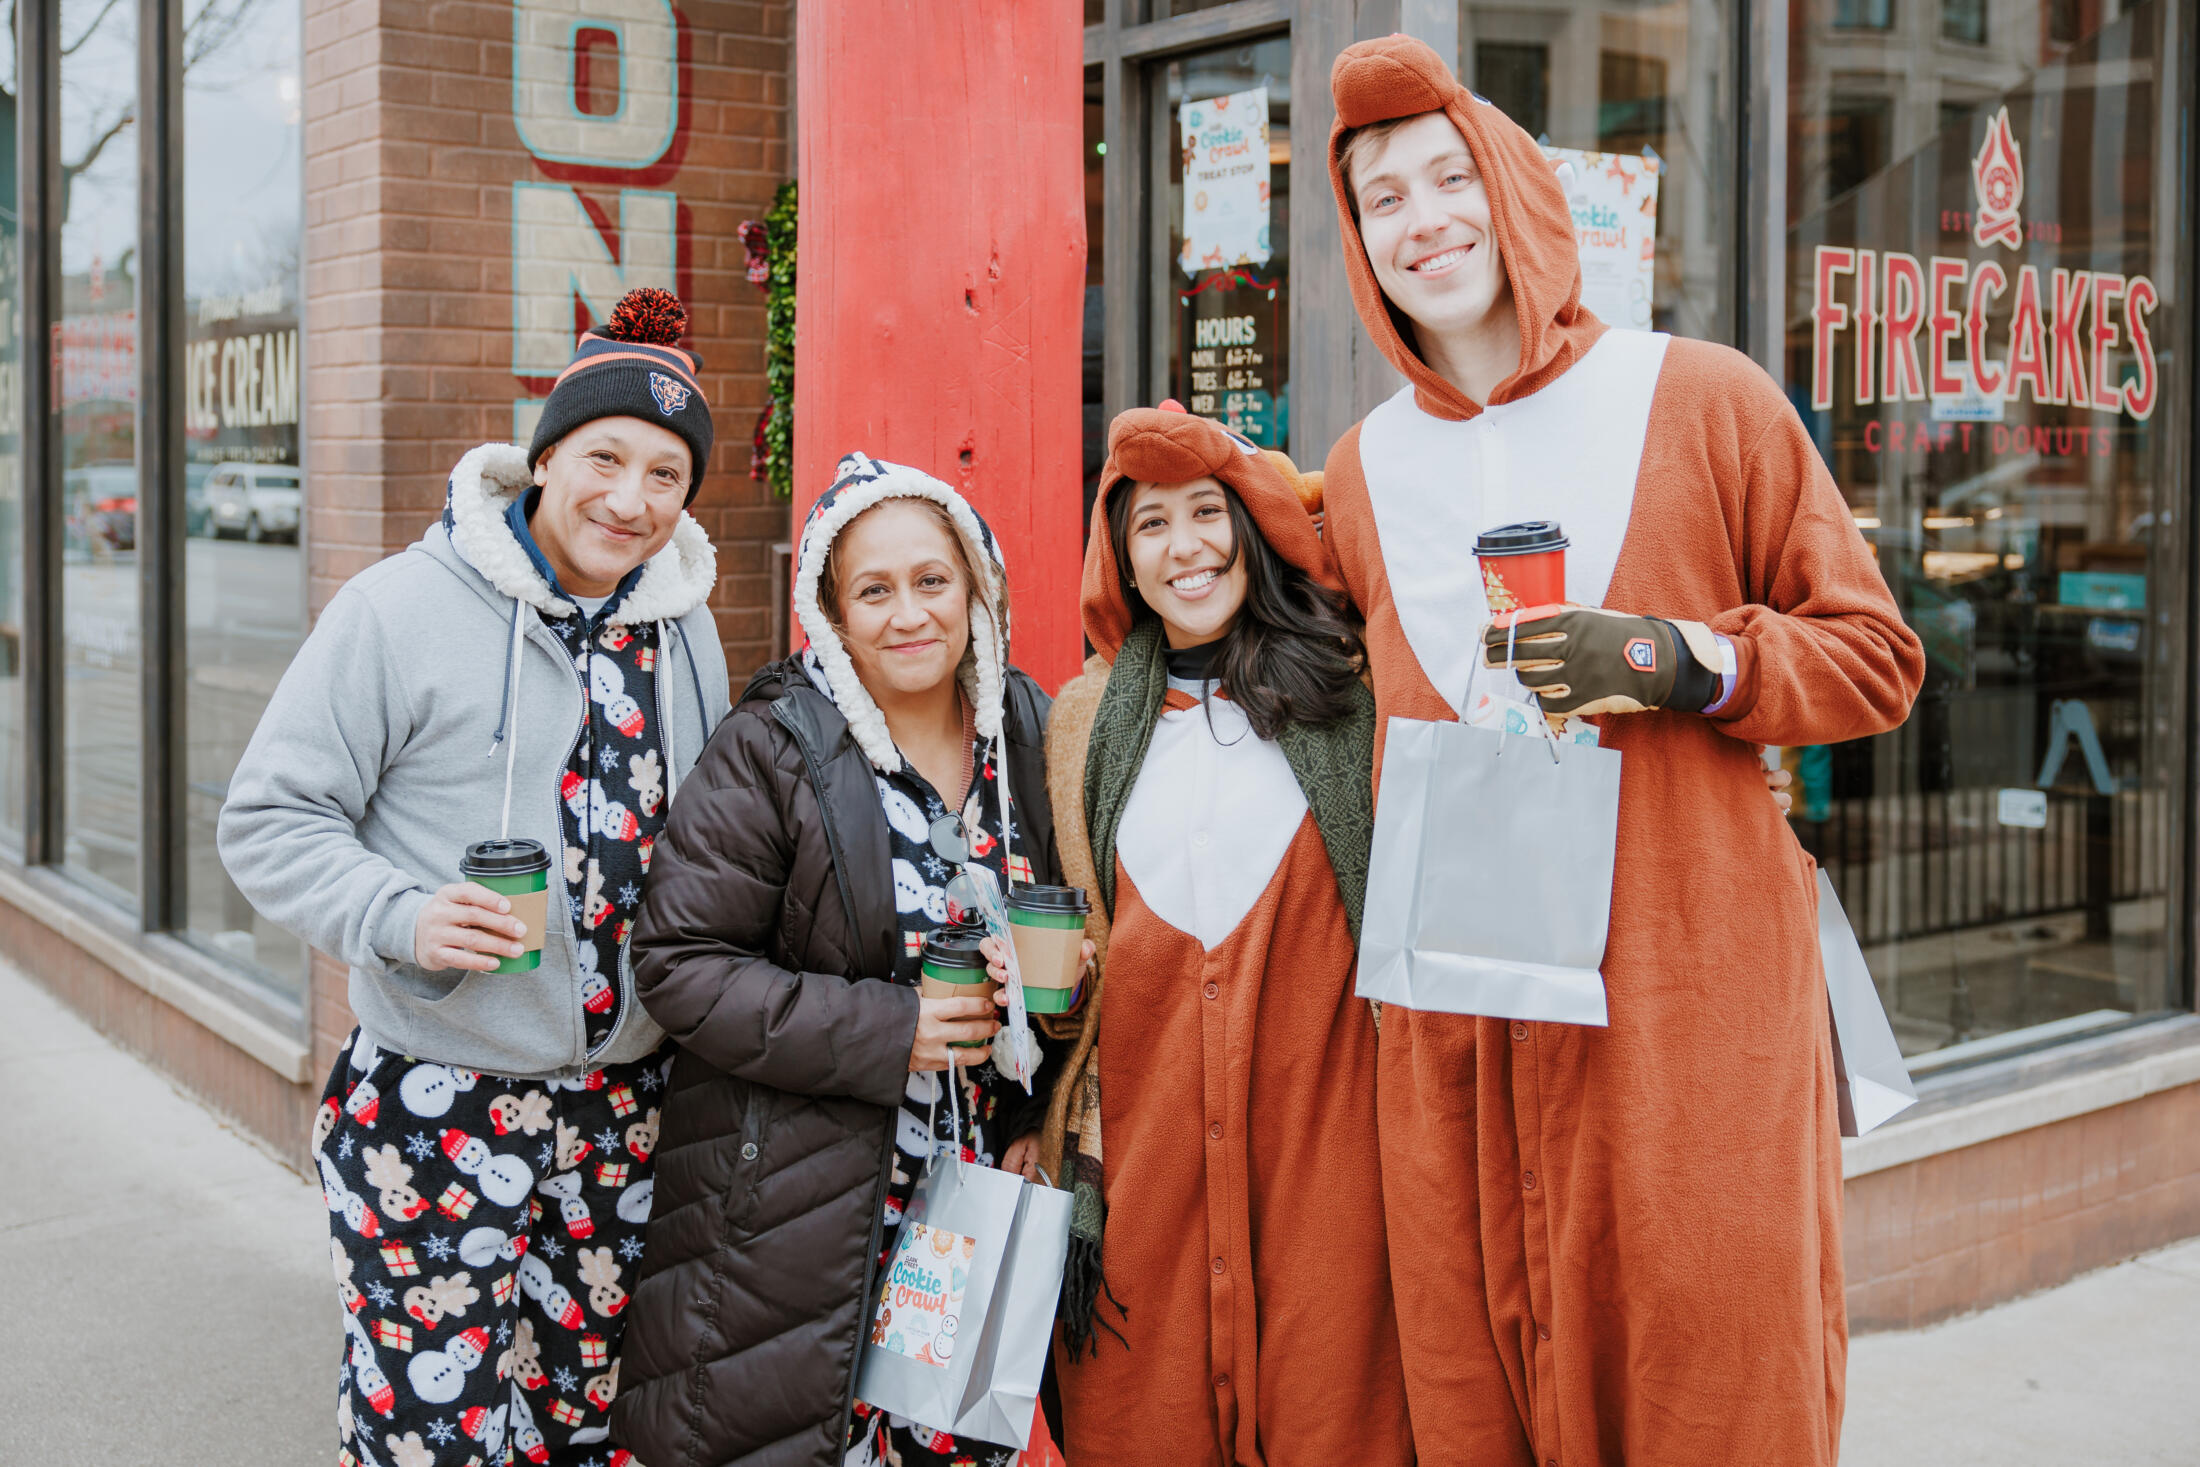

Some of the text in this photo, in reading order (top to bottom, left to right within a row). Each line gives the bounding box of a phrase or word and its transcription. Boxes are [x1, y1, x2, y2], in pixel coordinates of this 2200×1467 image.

[1572, 205, 1618, 229] ookie
[1576, 227, 1628, 249] rawl
[1196, 315, 1256, 348] HOURS
[1811, 245, 2159, 420] FIRECAKES
[186, 340, 218, 429] ICE
[221, 329, 298, 428] CREAM
[1864, 421, 2112, 457] CRAFT DONUTS
[893, 1262, 942, 1294] Cookie
[896, 1285, 947, 1315] Crawl
